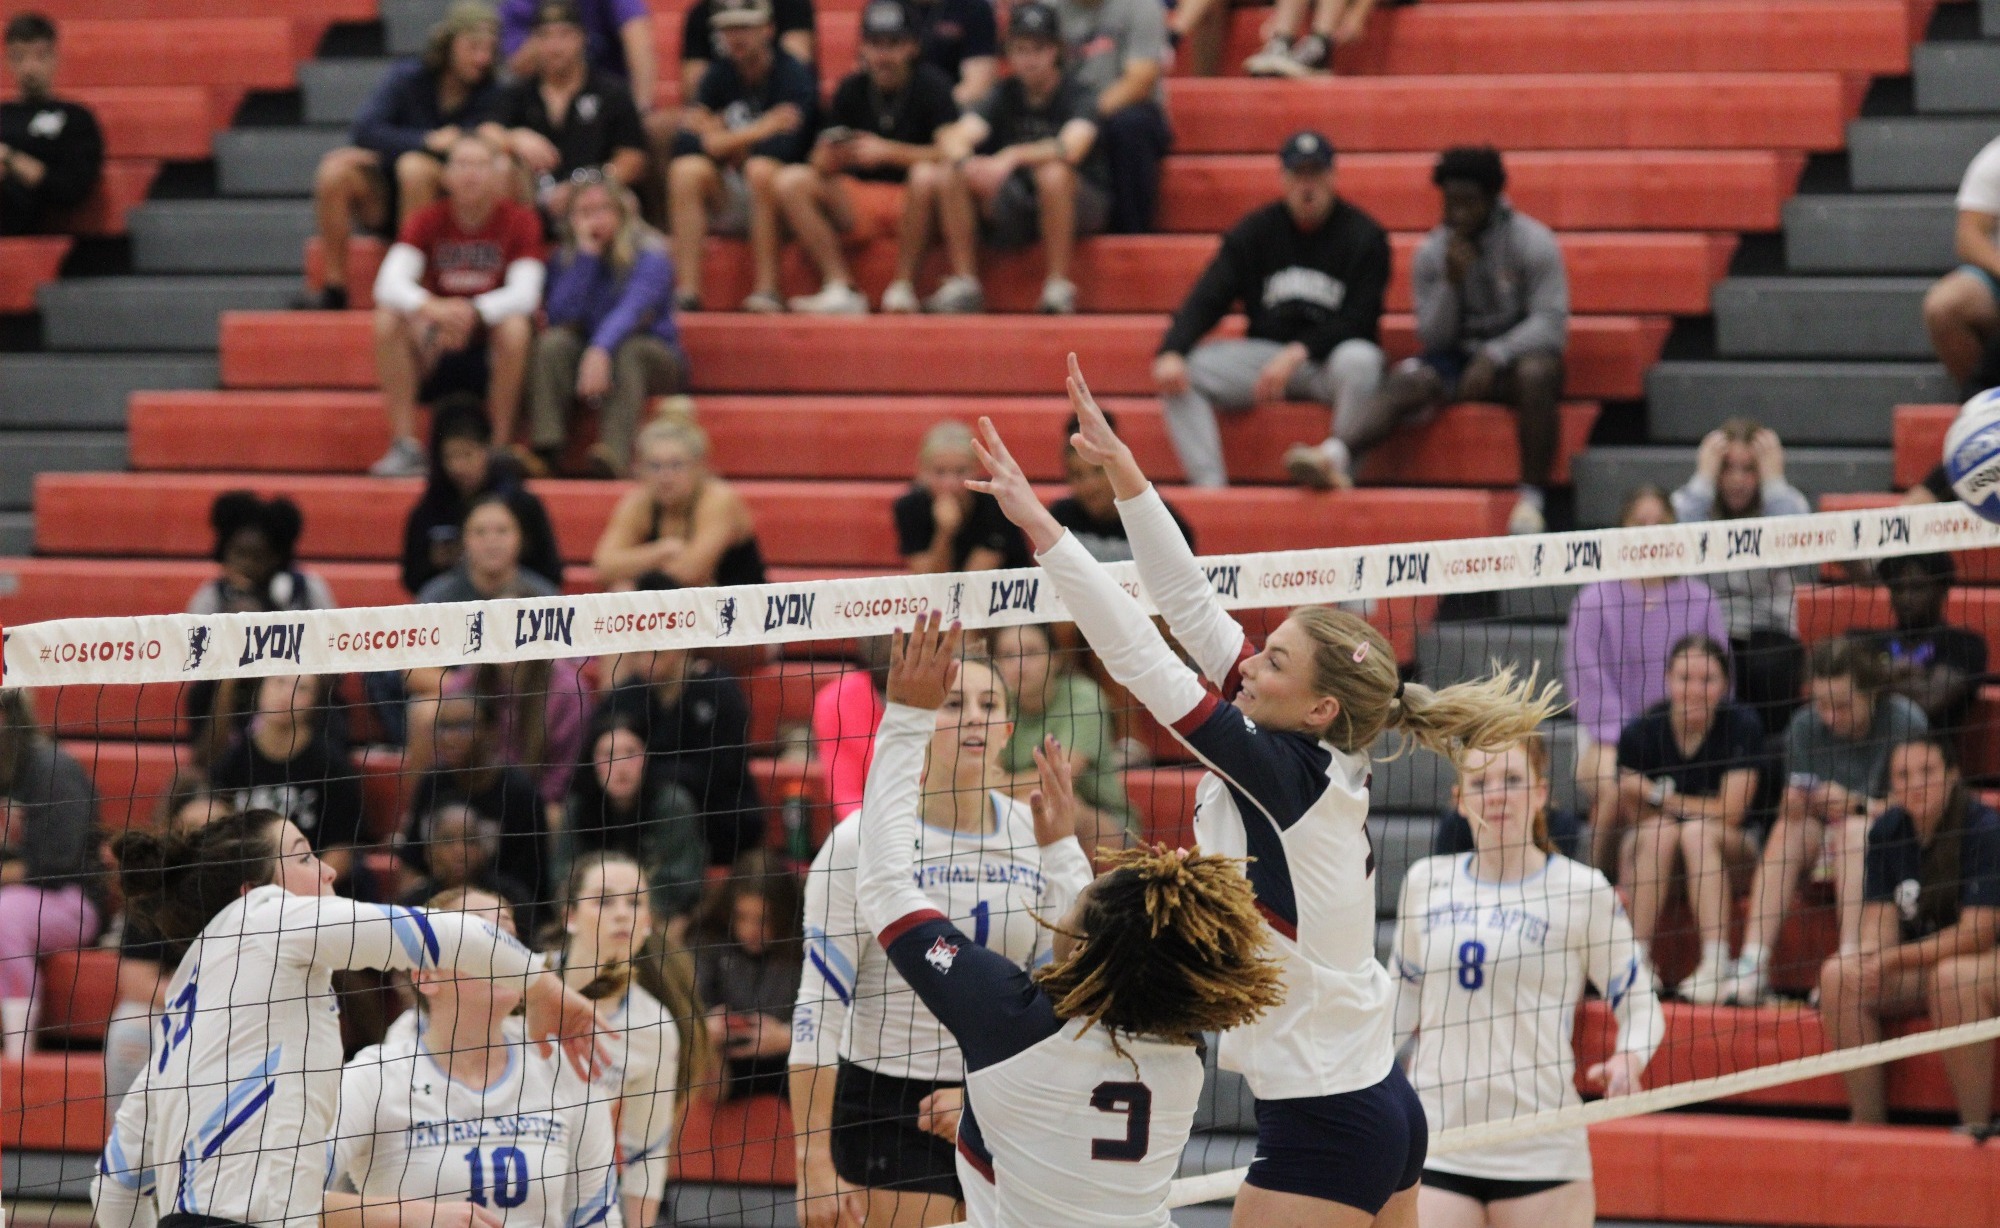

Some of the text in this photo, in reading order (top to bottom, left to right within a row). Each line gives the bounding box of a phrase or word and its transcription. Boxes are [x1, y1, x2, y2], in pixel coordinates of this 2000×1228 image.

[1727, 527, 1762, 559] LYON
[1879, 515, 1910, 546] LYON
[1386, 552, 1429, 588] LYON
[1564, 540, 1602, 573] LYON
[988, 578, 1039, 617] LYON
[1201, 565, 1241, 599] YON
[515, 607, 575, 649] LYON
[594, 611, 696, 634] #GOSCOTSGO
[764, 593, 816, 633] LYON
[239, 623, 304, 667] LYON
[328, 627, 439, 650] #GOSCOTSGO
[1458, 940, 1486, 990] 8
[1090, 1081, 1152, 1163] 9
[463, 1146, 529, 1209] 10
